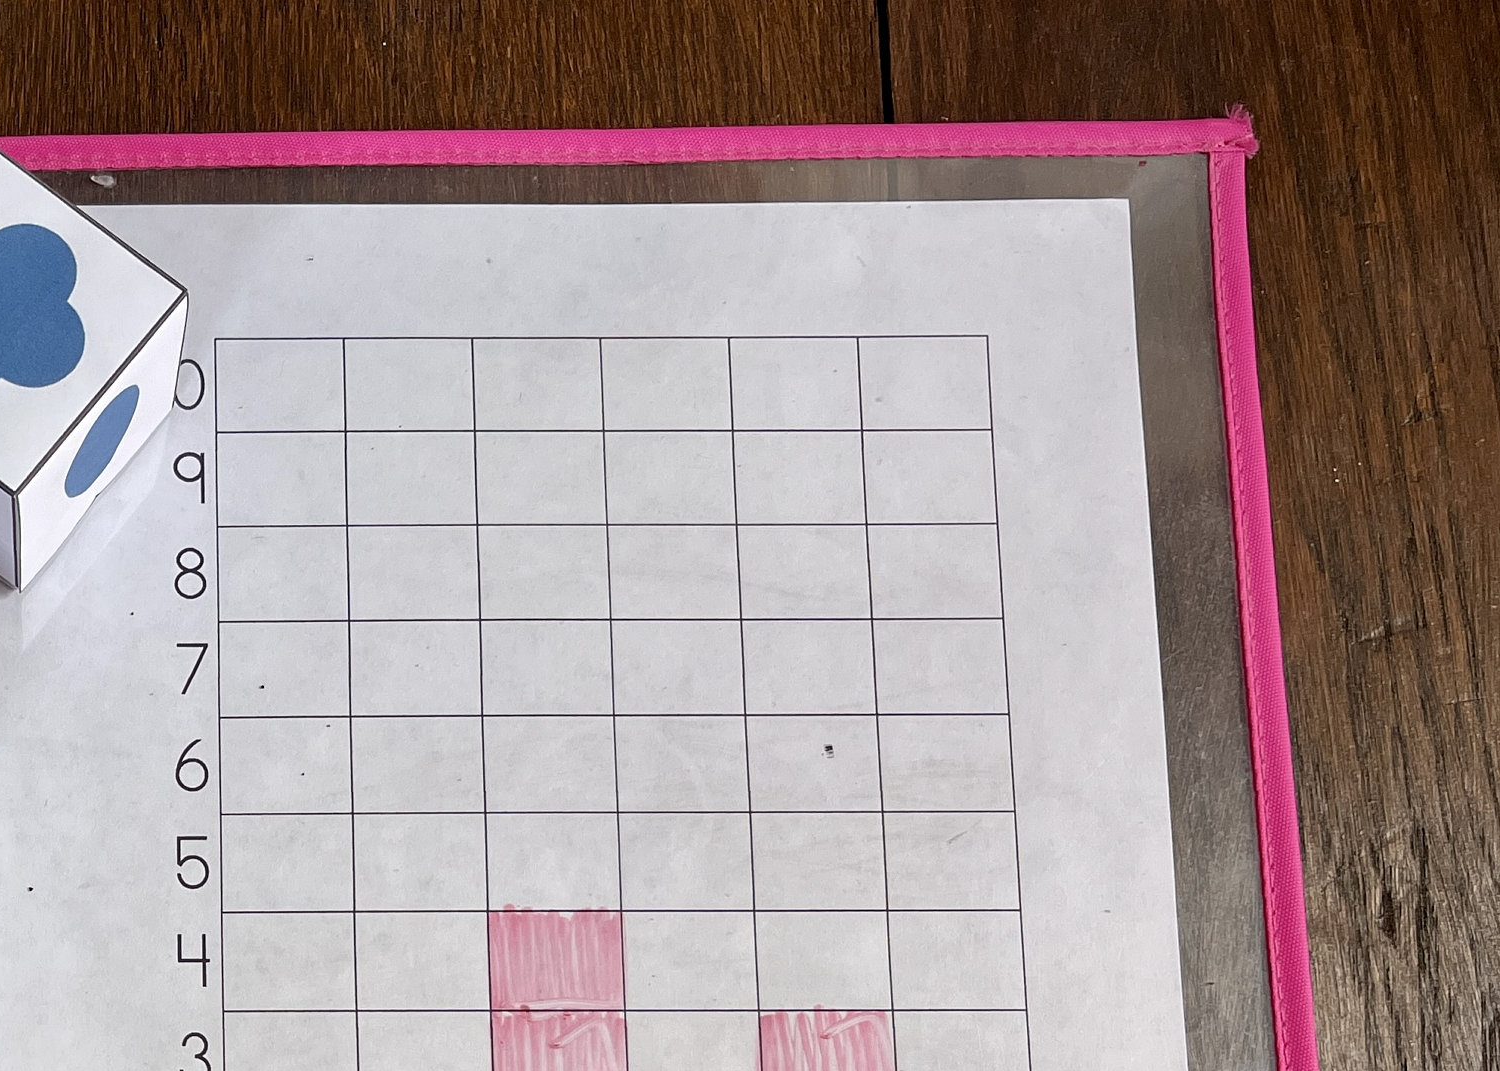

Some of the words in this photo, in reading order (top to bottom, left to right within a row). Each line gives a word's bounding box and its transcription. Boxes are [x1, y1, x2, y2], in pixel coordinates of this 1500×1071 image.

[174, 358, 205, 411] 0
[173, 451, 206, 504] 9
[174, 547, 207, 600] 8
[176, 642, 209, 695] 7
[175, 739, 209, 792] 6
[176, 835, 210, 890] 5
[177, 933, 212, 988] 4
